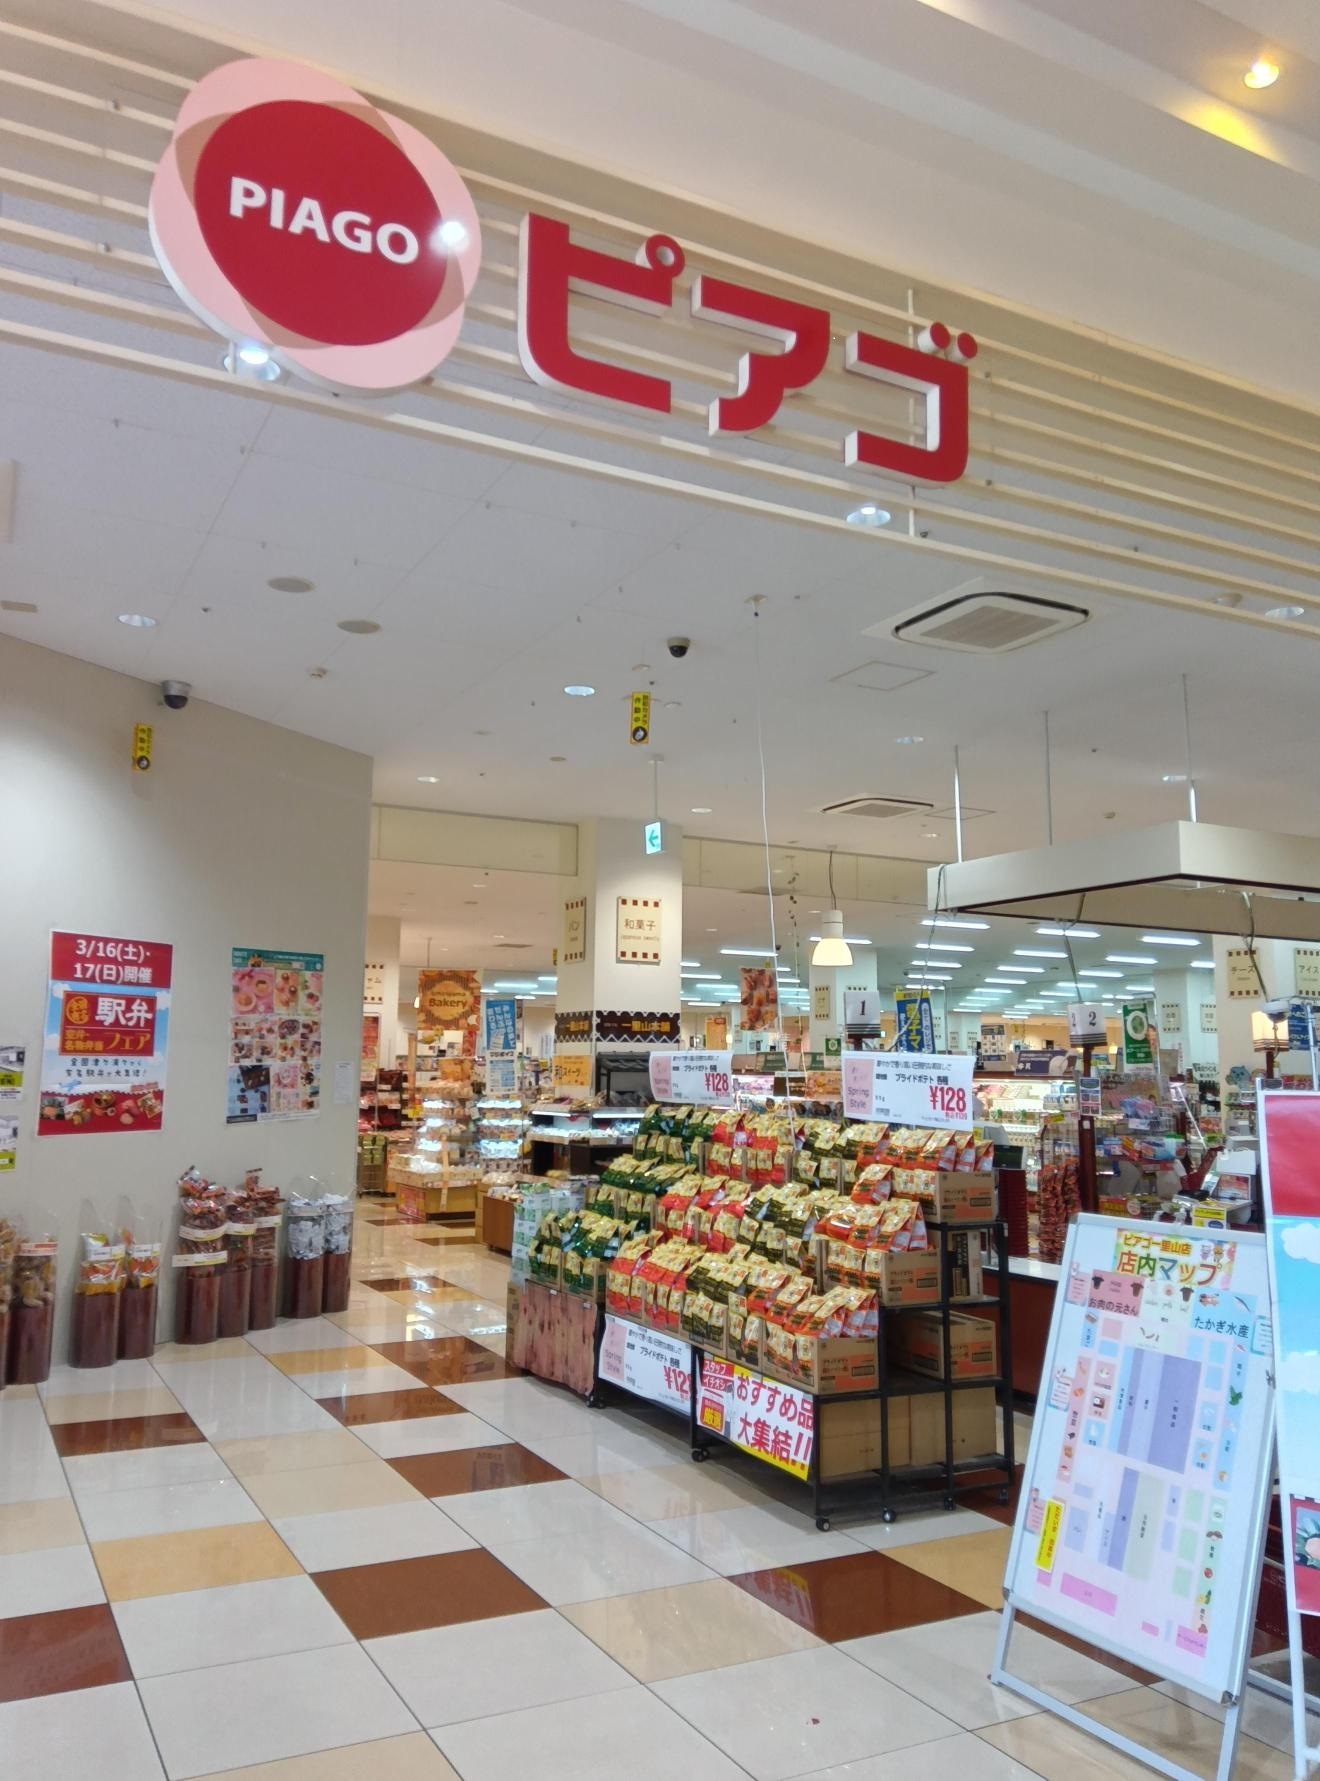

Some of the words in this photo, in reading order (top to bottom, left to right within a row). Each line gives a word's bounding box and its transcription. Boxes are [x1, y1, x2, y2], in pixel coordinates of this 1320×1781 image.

[228, 175, 421, 265] PIAGO
[519, 212, 979, 484] ピアゴ
[623, 918, 657, 932] 和菓子
[73, 963, 153, 984] 17(日)開催
[1231, 966, 1255, 974] チーズ
[1299, 965, 1320, 974] アイス
[95, 997, 153, 1027] 駅弁
[428, 998, 468, 1010] Bakery
[860, 1000, 866, 1016] 1
[1072, 1012, 1077, 1027] 2
[1088, 1011, 1097, 1026] 2
[104, 1031, 151, 1050] フェア
[704, 1073, 729, 1092] ¥128
[895, 1073, 934, 1084] プライドポテト
[848, 1087, 869, 1097] Spring
[929, 1085, 967, 1112] ¥128
[1123, 1234, 1193, 1256] ピアゴ一里山店
[1117, 1251, 1223, 1287] 店内マップ
[1194, 1316, 1250, 1339] たかぎ水産
[640, 1346, 668, 1363] プライドポテト
[704, 1360, 727, 1375] スタッフ
[703, 1377, 727, 1390] イチオシ
[736, 1372, 813, 1431] おすすめ品
[737, 1411, 813, 1471] 大集結!!
